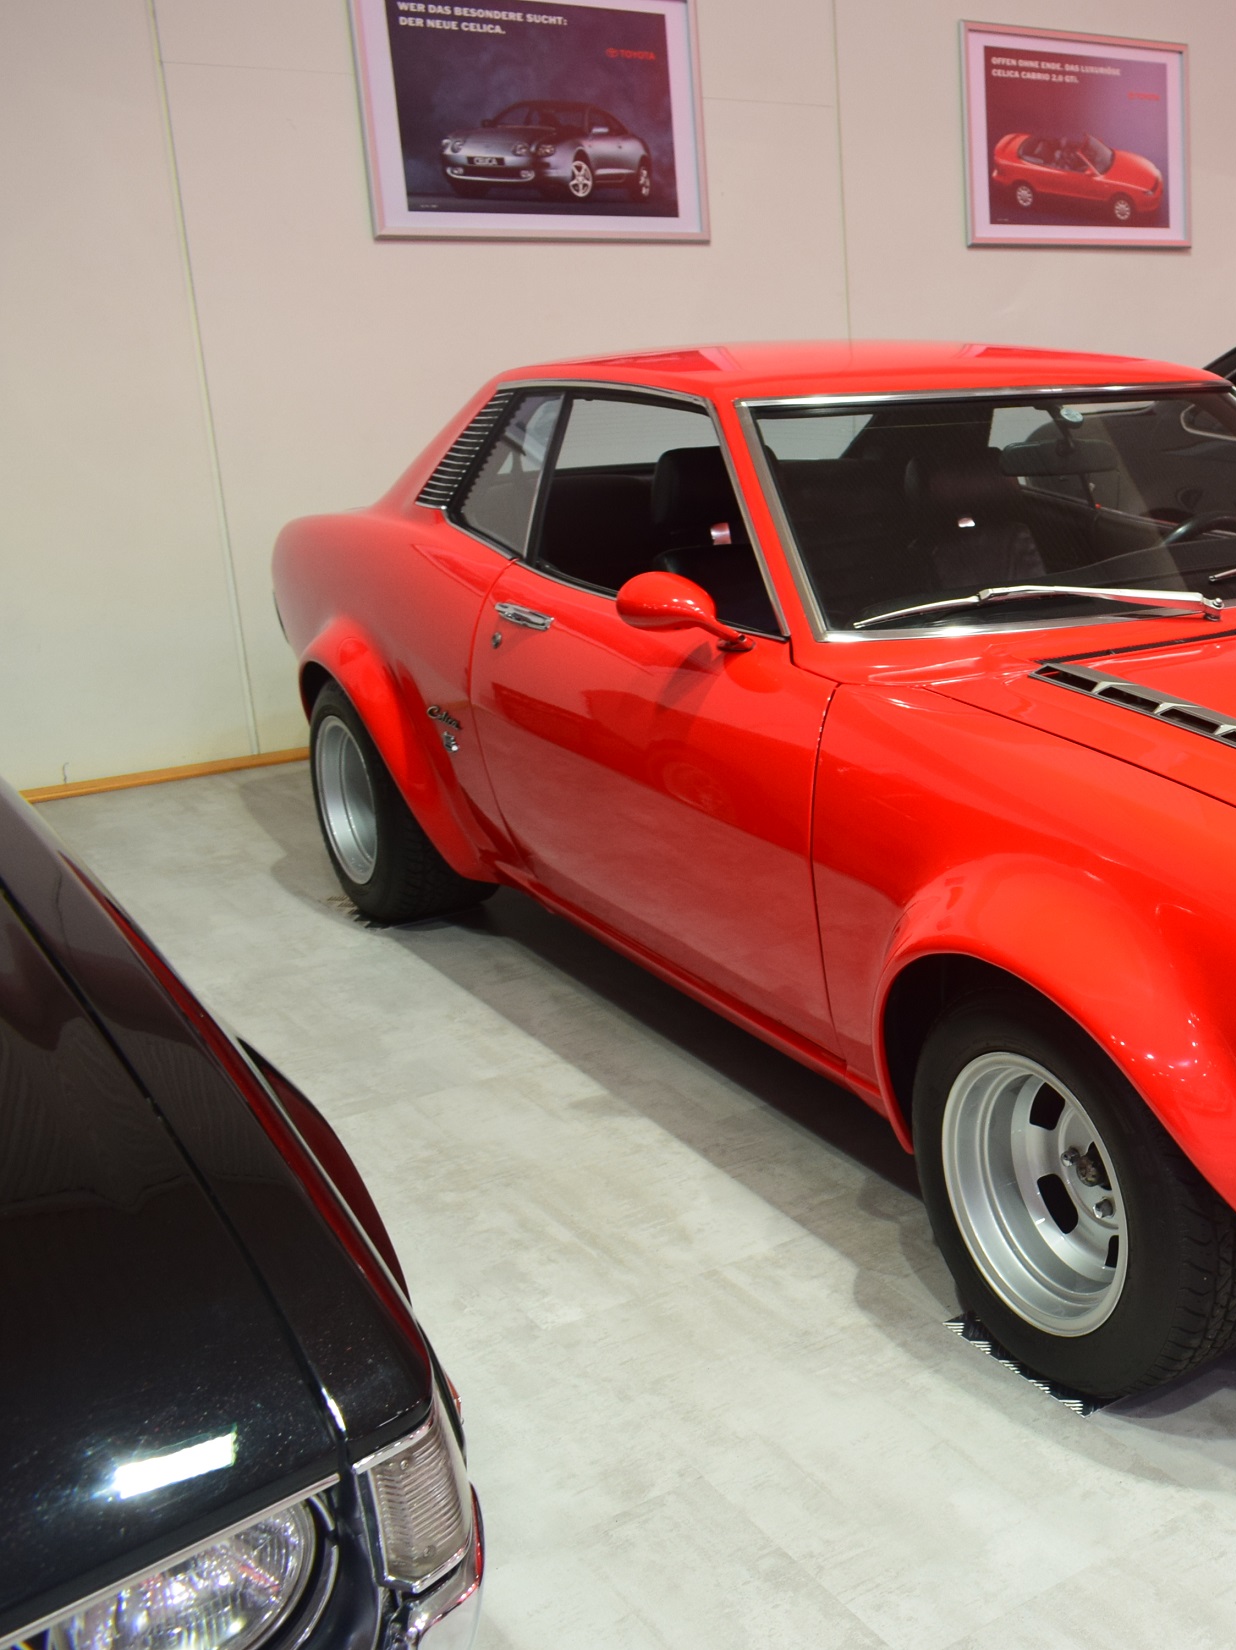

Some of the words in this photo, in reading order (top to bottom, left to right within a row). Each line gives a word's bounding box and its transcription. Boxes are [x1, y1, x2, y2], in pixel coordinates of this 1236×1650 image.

[397, 1, 426, 12] WER
[428, 4, 451, 15] DAS
[454, 6, 524, 21] BESONDERE
[526, 13, 568, 25] SUCHT:
[399, 16, 424, 27] DER
[426, 19, 459, 30] NEUE
[461, 22, 506, 34] CELICA.
[620, 49, 656, 60] TOYOTA
[991, 57, 1017, 66] OFFEN
[1018, 59, 1039, 68] OHNE
[1064, 63, 1080, 72] DAS
[992, 69, 1020, 78] CELICA
[1021, 71, 1050, 80] CABRIO
[427, 705, 461, 730] Celica
